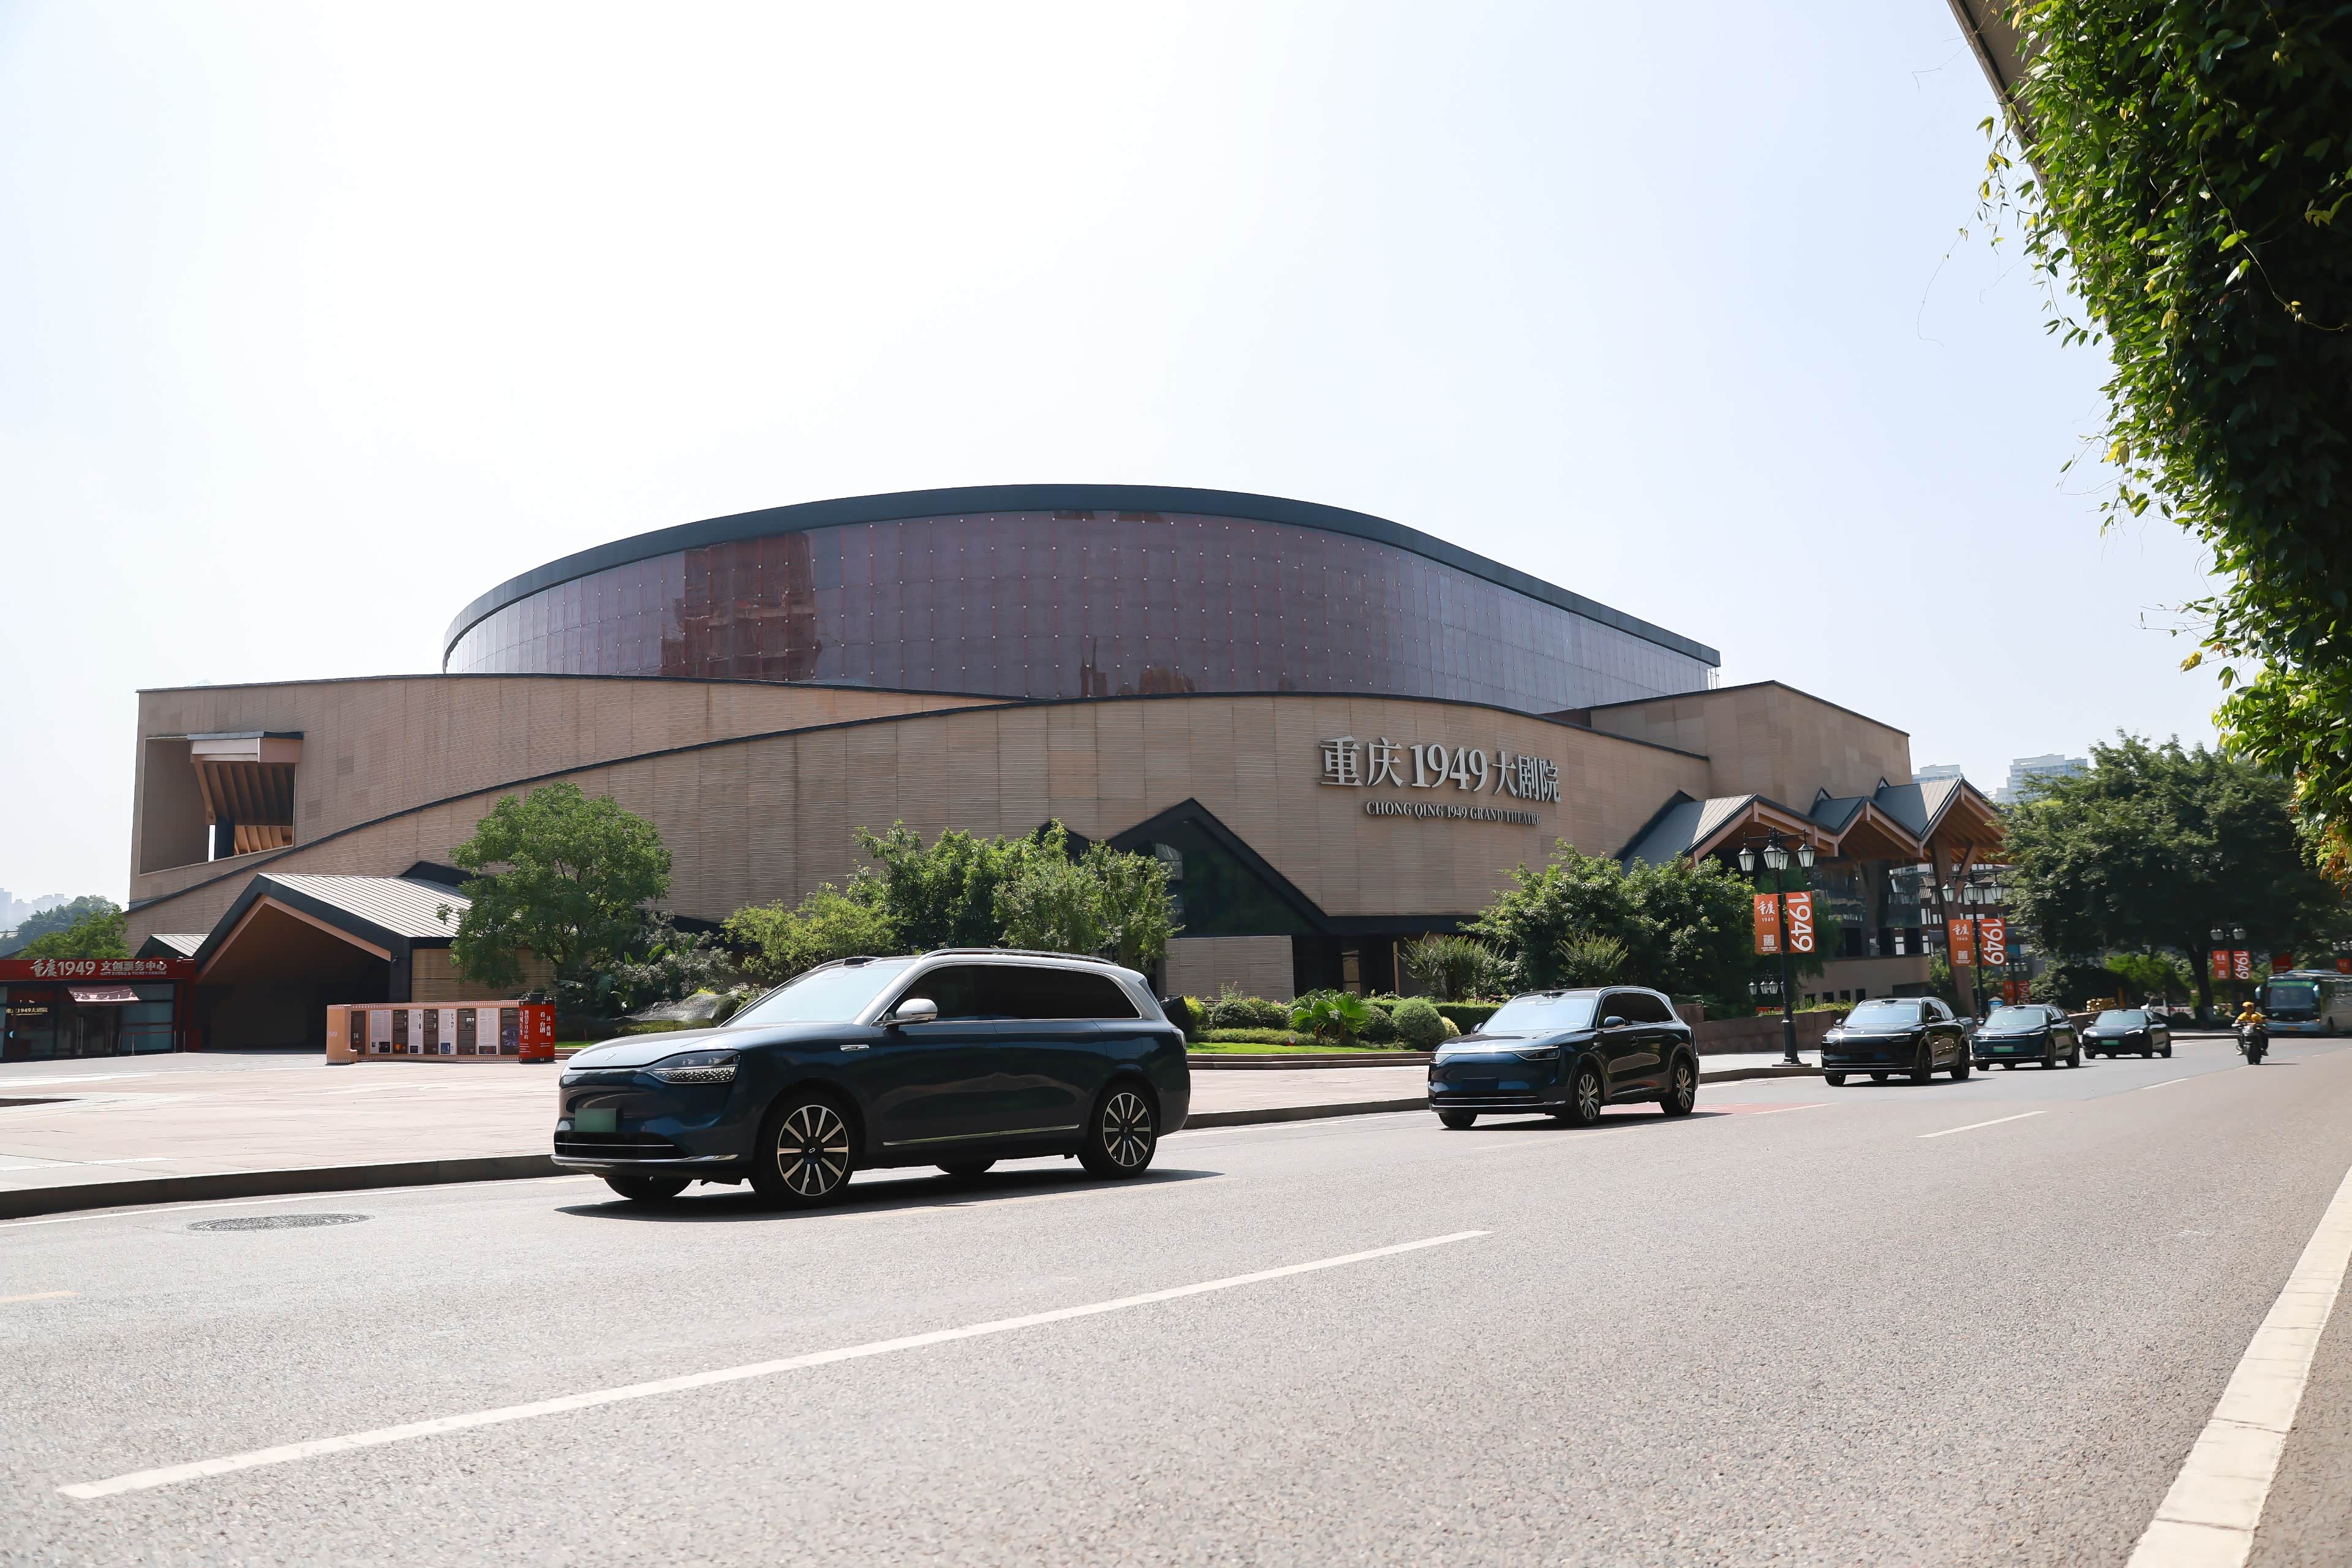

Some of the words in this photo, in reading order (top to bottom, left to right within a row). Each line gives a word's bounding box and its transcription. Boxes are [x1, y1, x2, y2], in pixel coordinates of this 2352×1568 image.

[1320, 736, 1561, 802] 重庆1949大剧院
[1366, 801, 1411, 816] CHONG
[1414, 803, 1443, 819] QING
[1447, 805, 1467, 818] 1949
[1470, 807, 1503, 821] GRAND
[1506, 810, 1540, 825] THEATRE
[1788, 892, 1813, 951] 1949
[1982, 919, 2004, 965] 1949
[100, 960, 167, 971] 文创票务中心
[2234, 951, 2249, 979] 1949
[2018, 981, 2030, 1005] 1949
